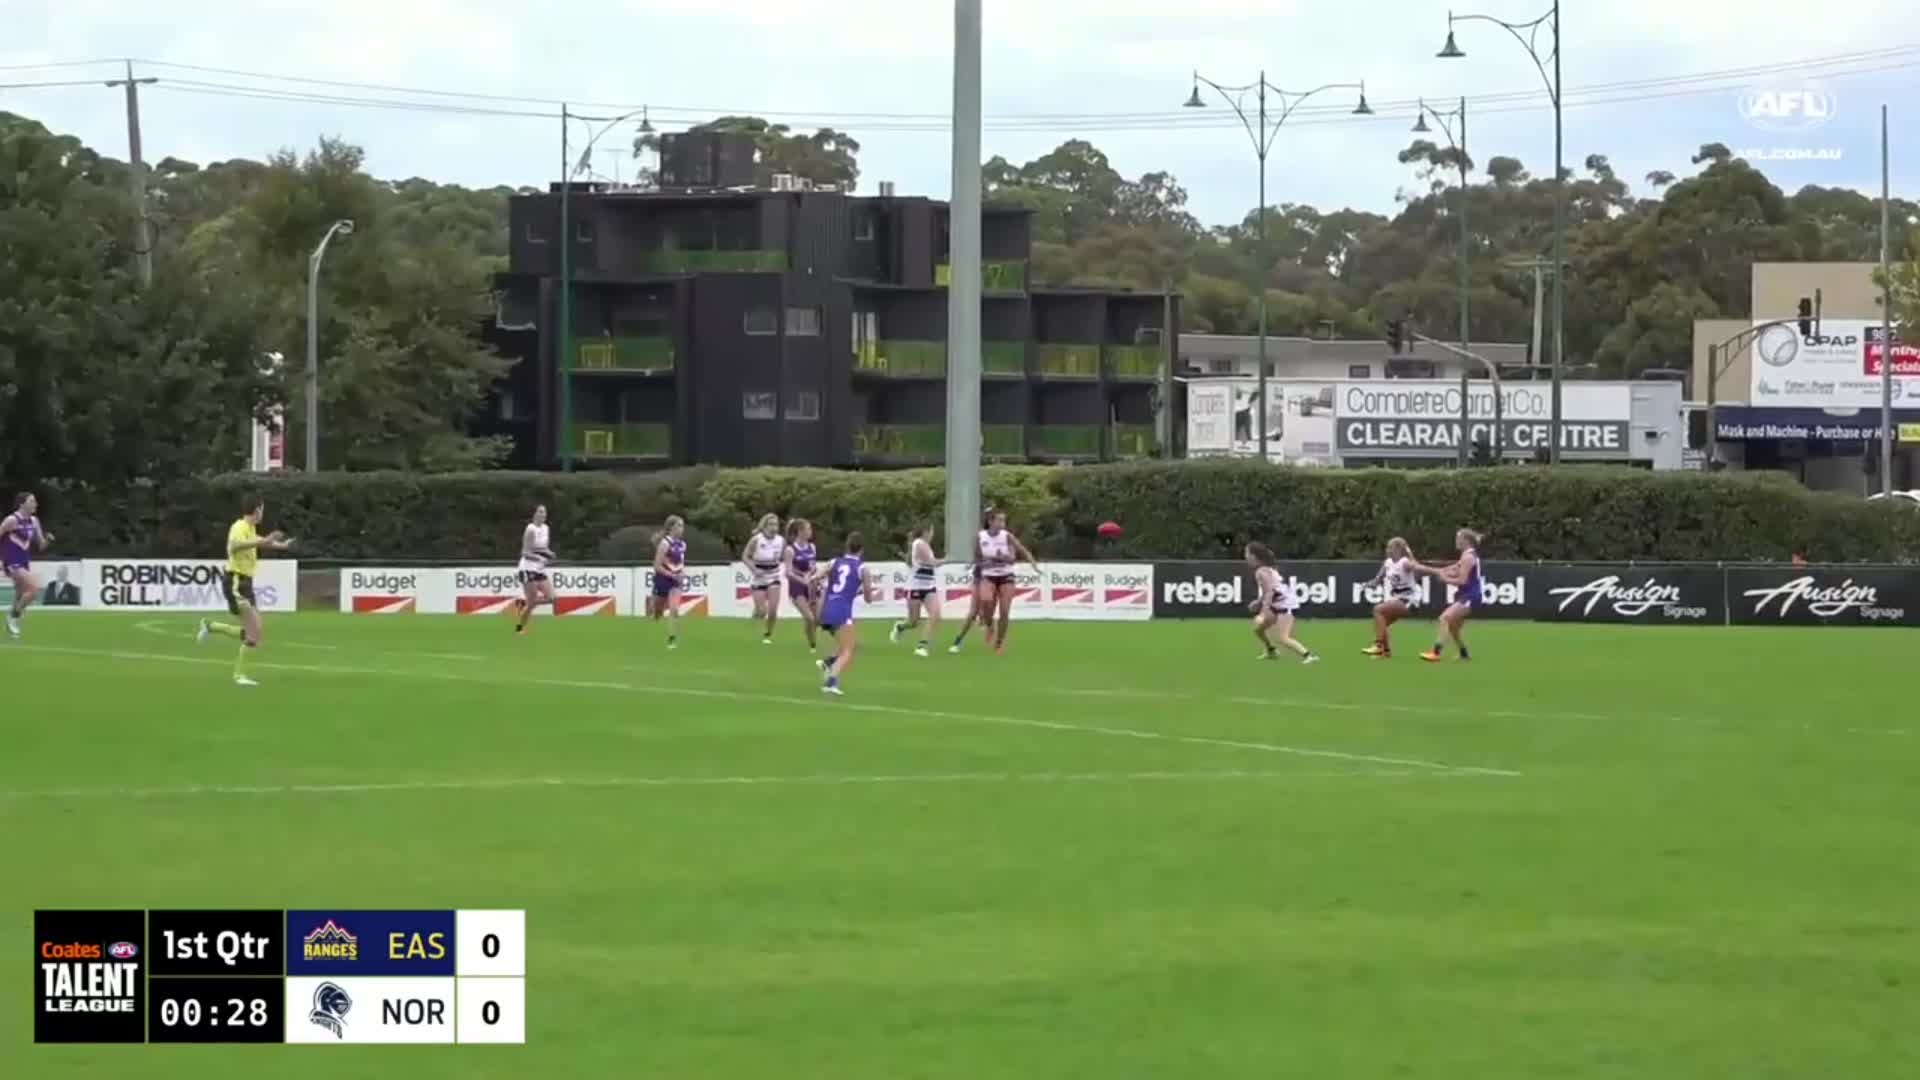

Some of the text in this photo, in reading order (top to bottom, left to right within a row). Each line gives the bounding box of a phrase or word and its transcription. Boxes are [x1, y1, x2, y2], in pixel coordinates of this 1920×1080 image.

[1718, 424, 1743, 437] Mask
[1747, 424, 1765, 437] and
[1766, 425, 1808, 438] Machine
[101, 564, 225, 586] ROBINSON
[351, 572, 416, 594] Budget
[456, 572, 520, 594] Budget
[553, 572, 616, 594] Budget
[645, 571, 708, 592] Bget
[833, 564, 849, 593] 3
[1051, 573, 1094, 588] Budget
[1104, 574, 1149, 588] Budget
[1164, 576, 1242, 604] rebel
[1446, 576, 1525, 604] rbel
[1663, 604, 1707, 619] Signage
[1859, 605, 1904, 620] Signage
